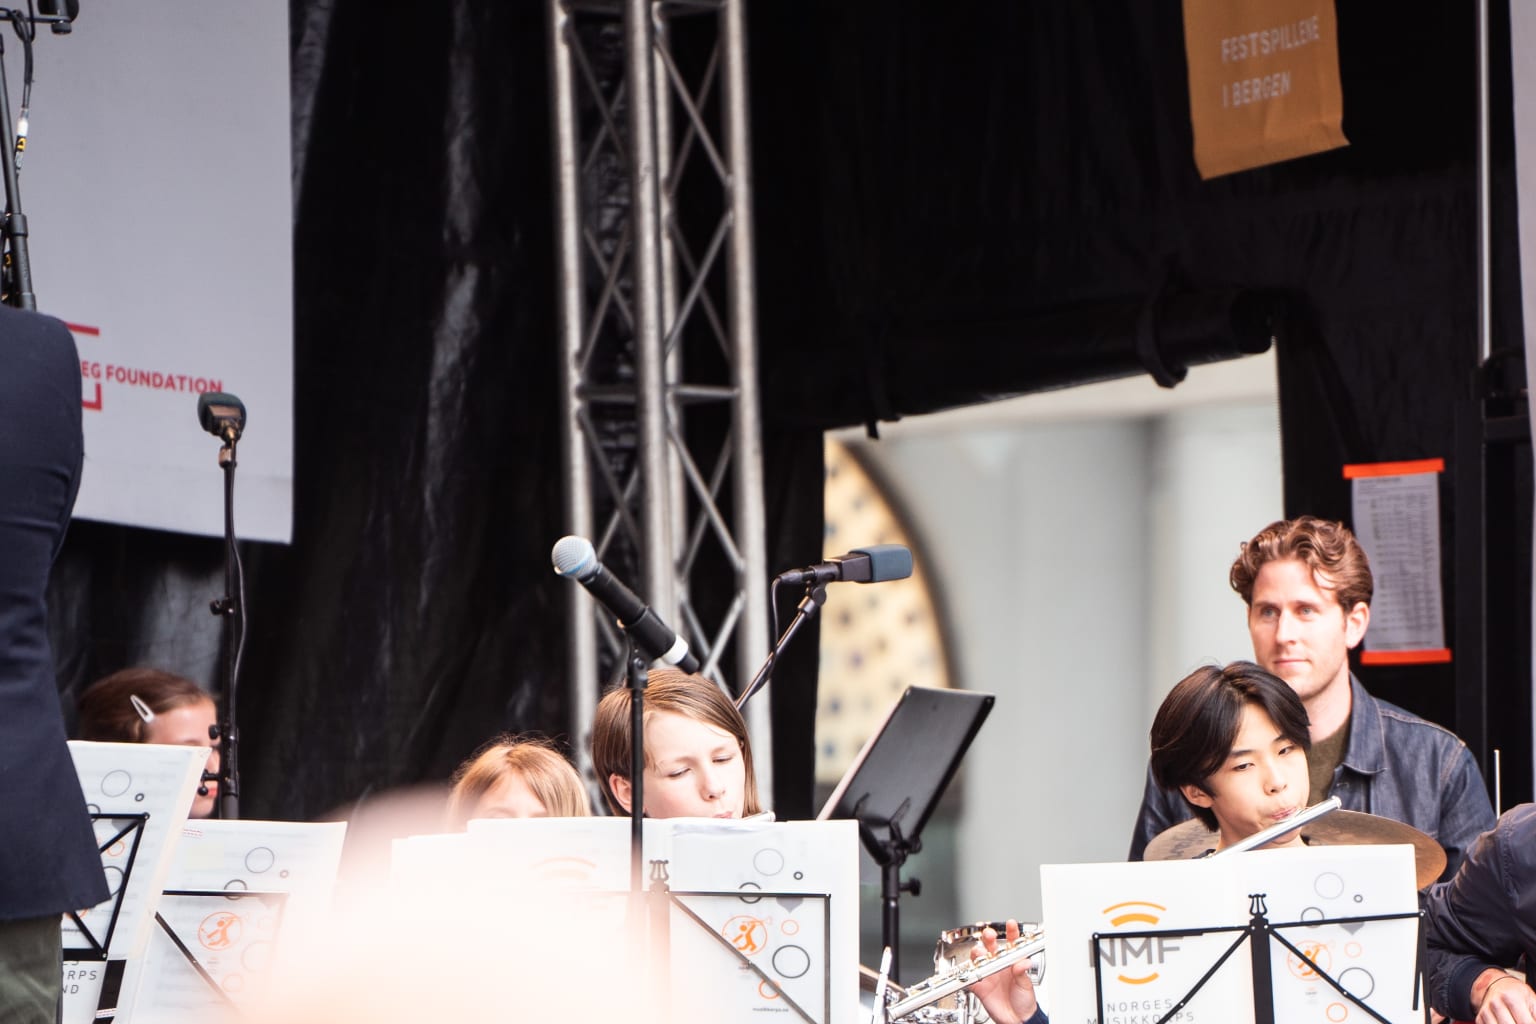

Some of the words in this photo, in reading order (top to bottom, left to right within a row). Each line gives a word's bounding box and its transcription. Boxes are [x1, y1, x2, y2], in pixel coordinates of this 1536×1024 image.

[1221, 15, 1319, 63] FESTSPILLENE
[1223, 84, 1229, 108] I
[1232, 71, 1291, 107] BERGEN
[80, 360, 101, 378] EG
[106, 365, 222, 394] FOUNDATION
[1088, 936, 1183, 968] NMF
[1107, 999, 1173, 1013] NORGES
